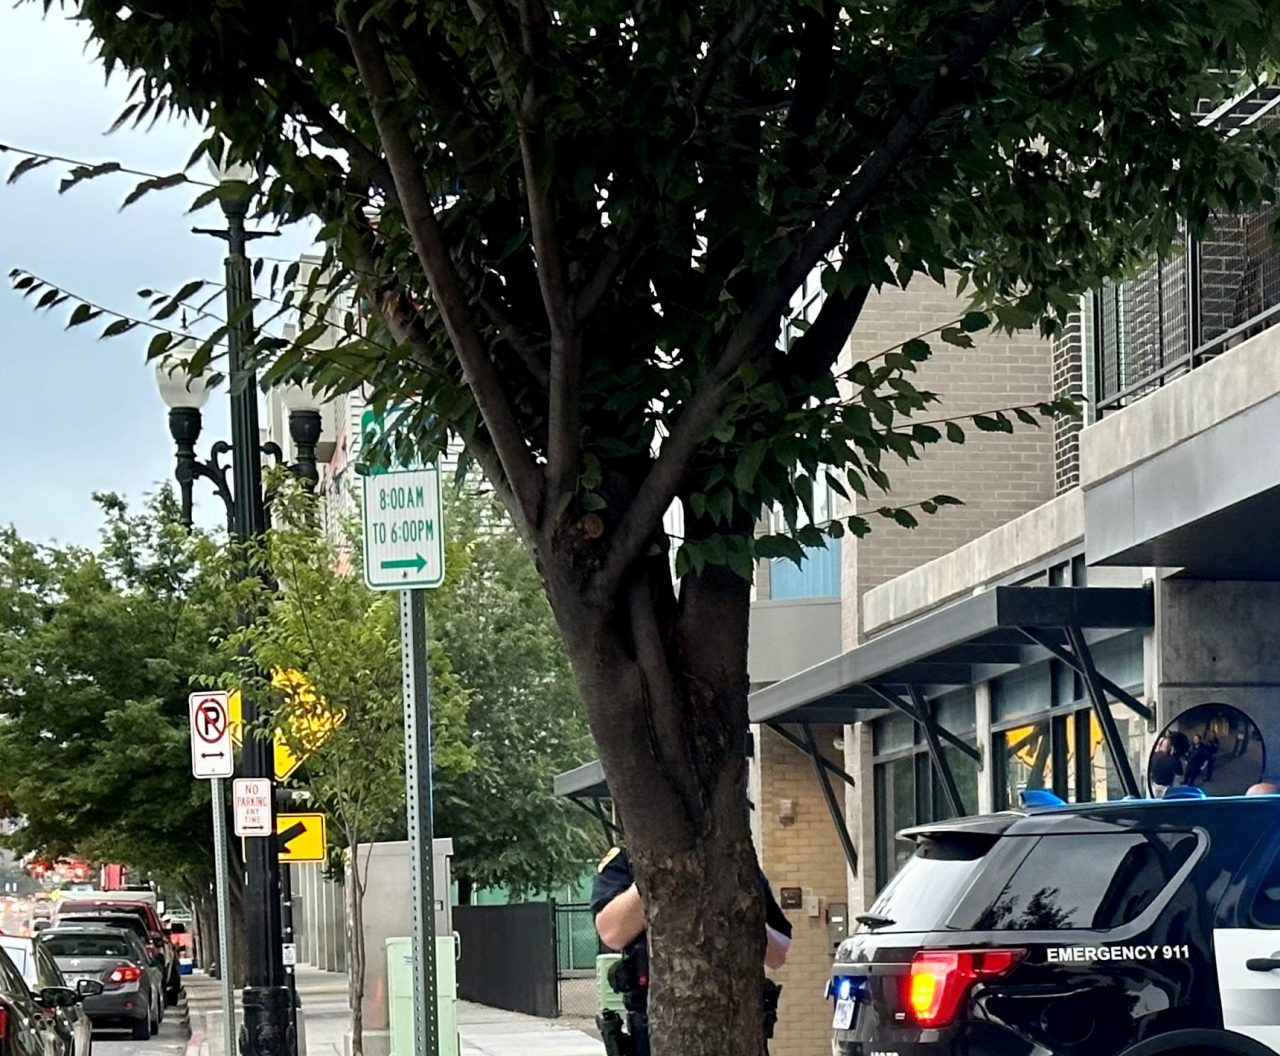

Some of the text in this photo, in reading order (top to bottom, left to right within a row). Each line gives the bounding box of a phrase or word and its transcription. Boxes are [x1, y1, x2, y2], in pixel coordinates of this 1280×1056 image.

[379, 486, 424, 511] 8:00AM
[373, 520, 434, 545] TO 6:00PM
[245, 784, 259, 796] NO
[237, 796, 268, 807] PARKING
[1046, 945, 1190, 962] EMERGENCY 911
